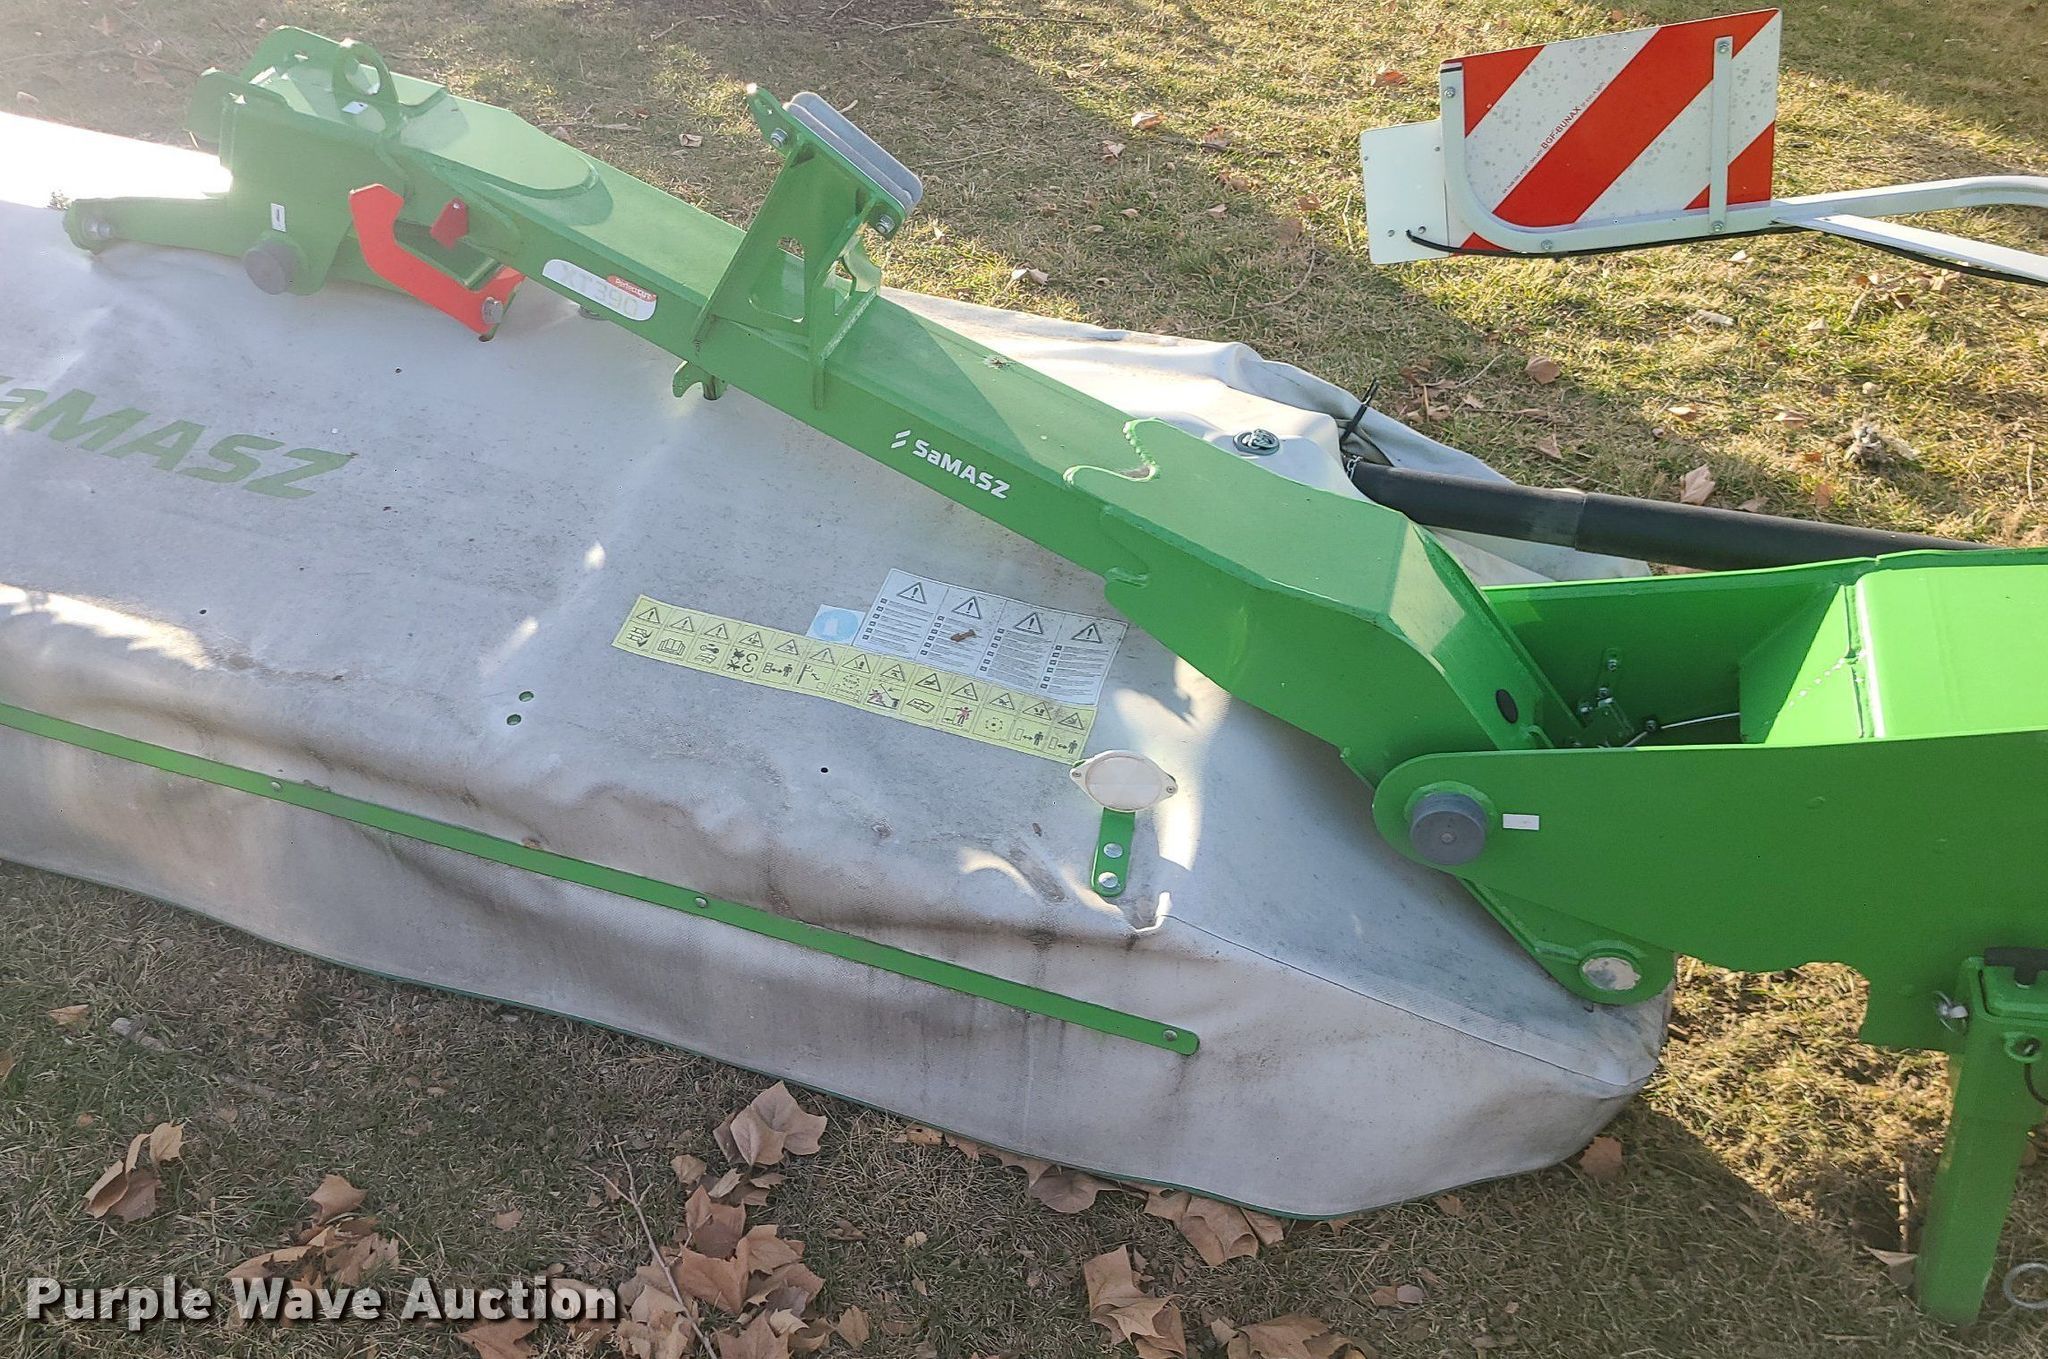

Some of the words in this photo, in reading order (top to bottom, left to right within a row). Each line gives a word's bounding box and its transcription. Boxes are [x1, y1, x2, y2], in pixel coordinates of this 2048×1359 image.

[1540, 106, 1582, 150] BGF-BUNAX
[0, 376, 353, 499] aMASZ
[912, 439, 1011, 499] SaMASZ
